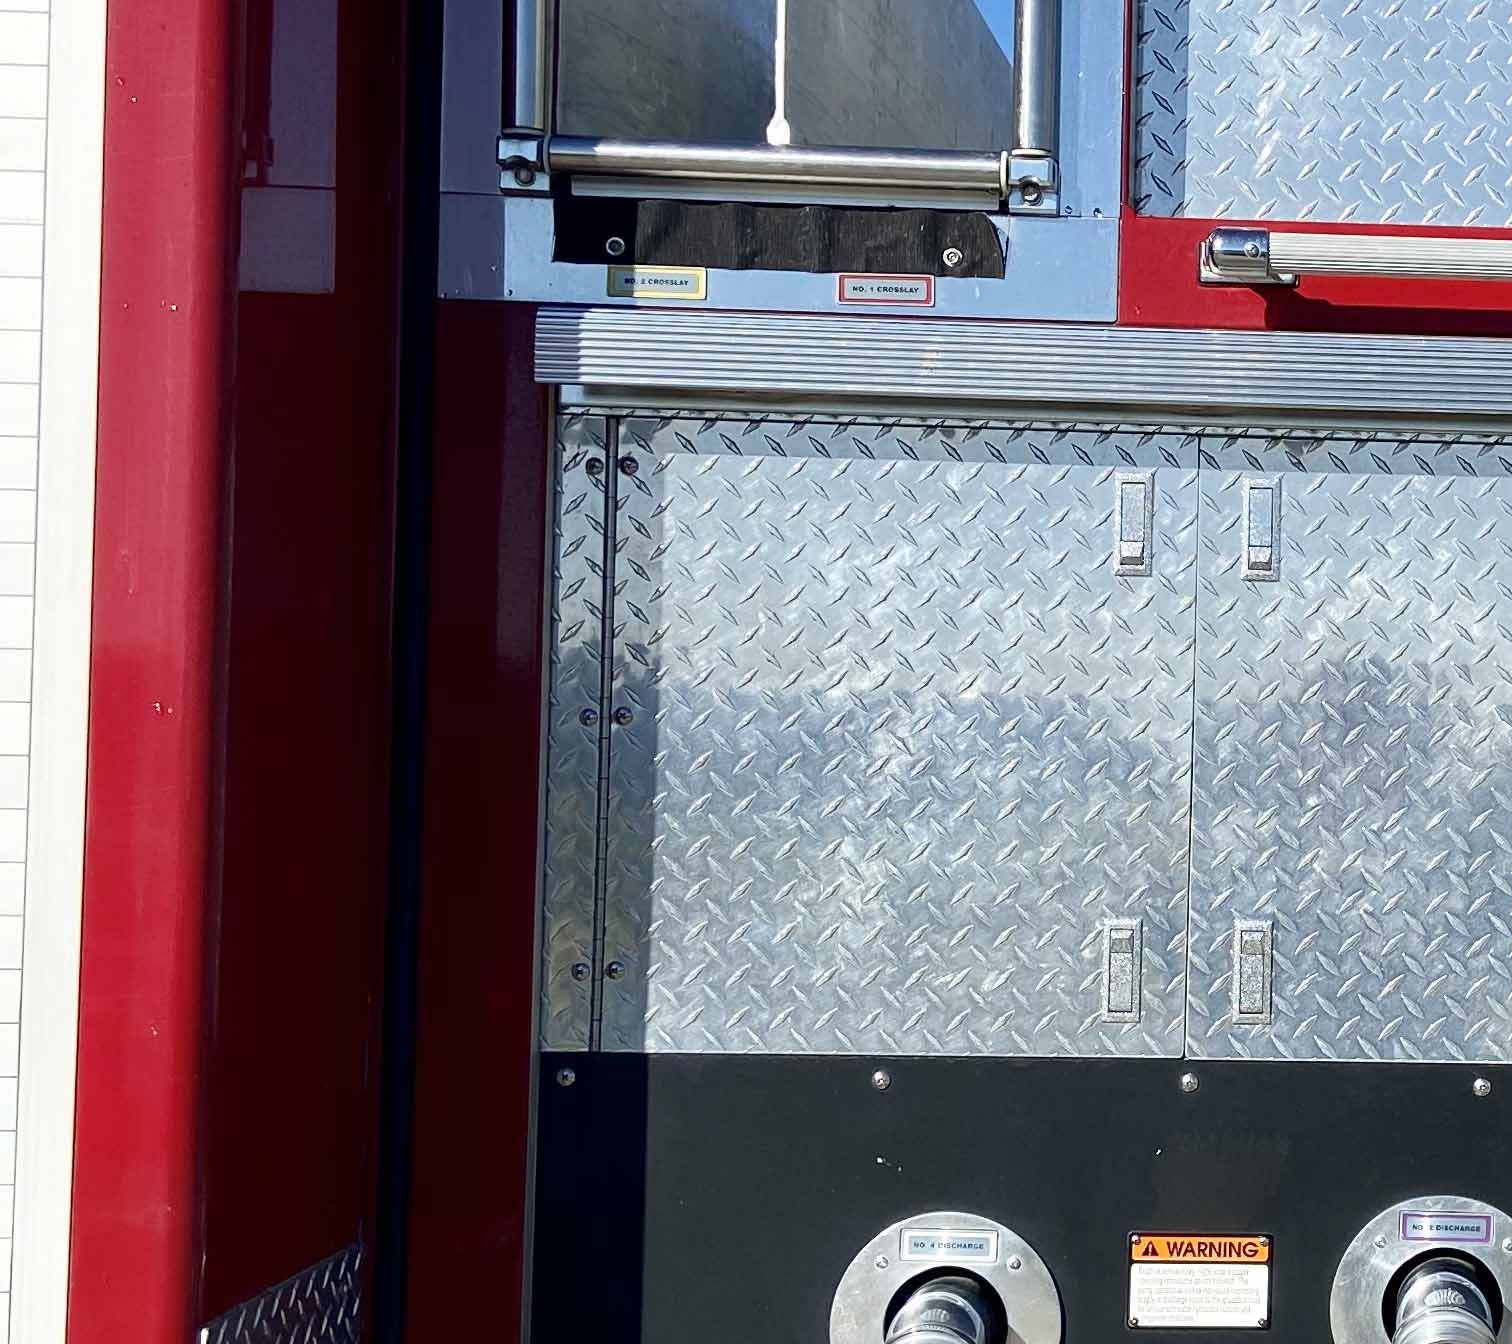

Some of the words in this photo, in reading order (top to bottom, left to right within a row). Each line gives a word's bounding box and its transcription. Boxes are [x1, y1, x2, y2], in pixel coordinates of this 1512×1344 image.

[648, 278, 689, 286] CROSSLAY
[876, 286, 919, 294] CROSSLAY
[1435, 1224, 1481, 1233] DISCHARGE
[938, 1242, 985, 1250] DISCHARGE
[1166, 1241, 1259, 1258] WARNING
